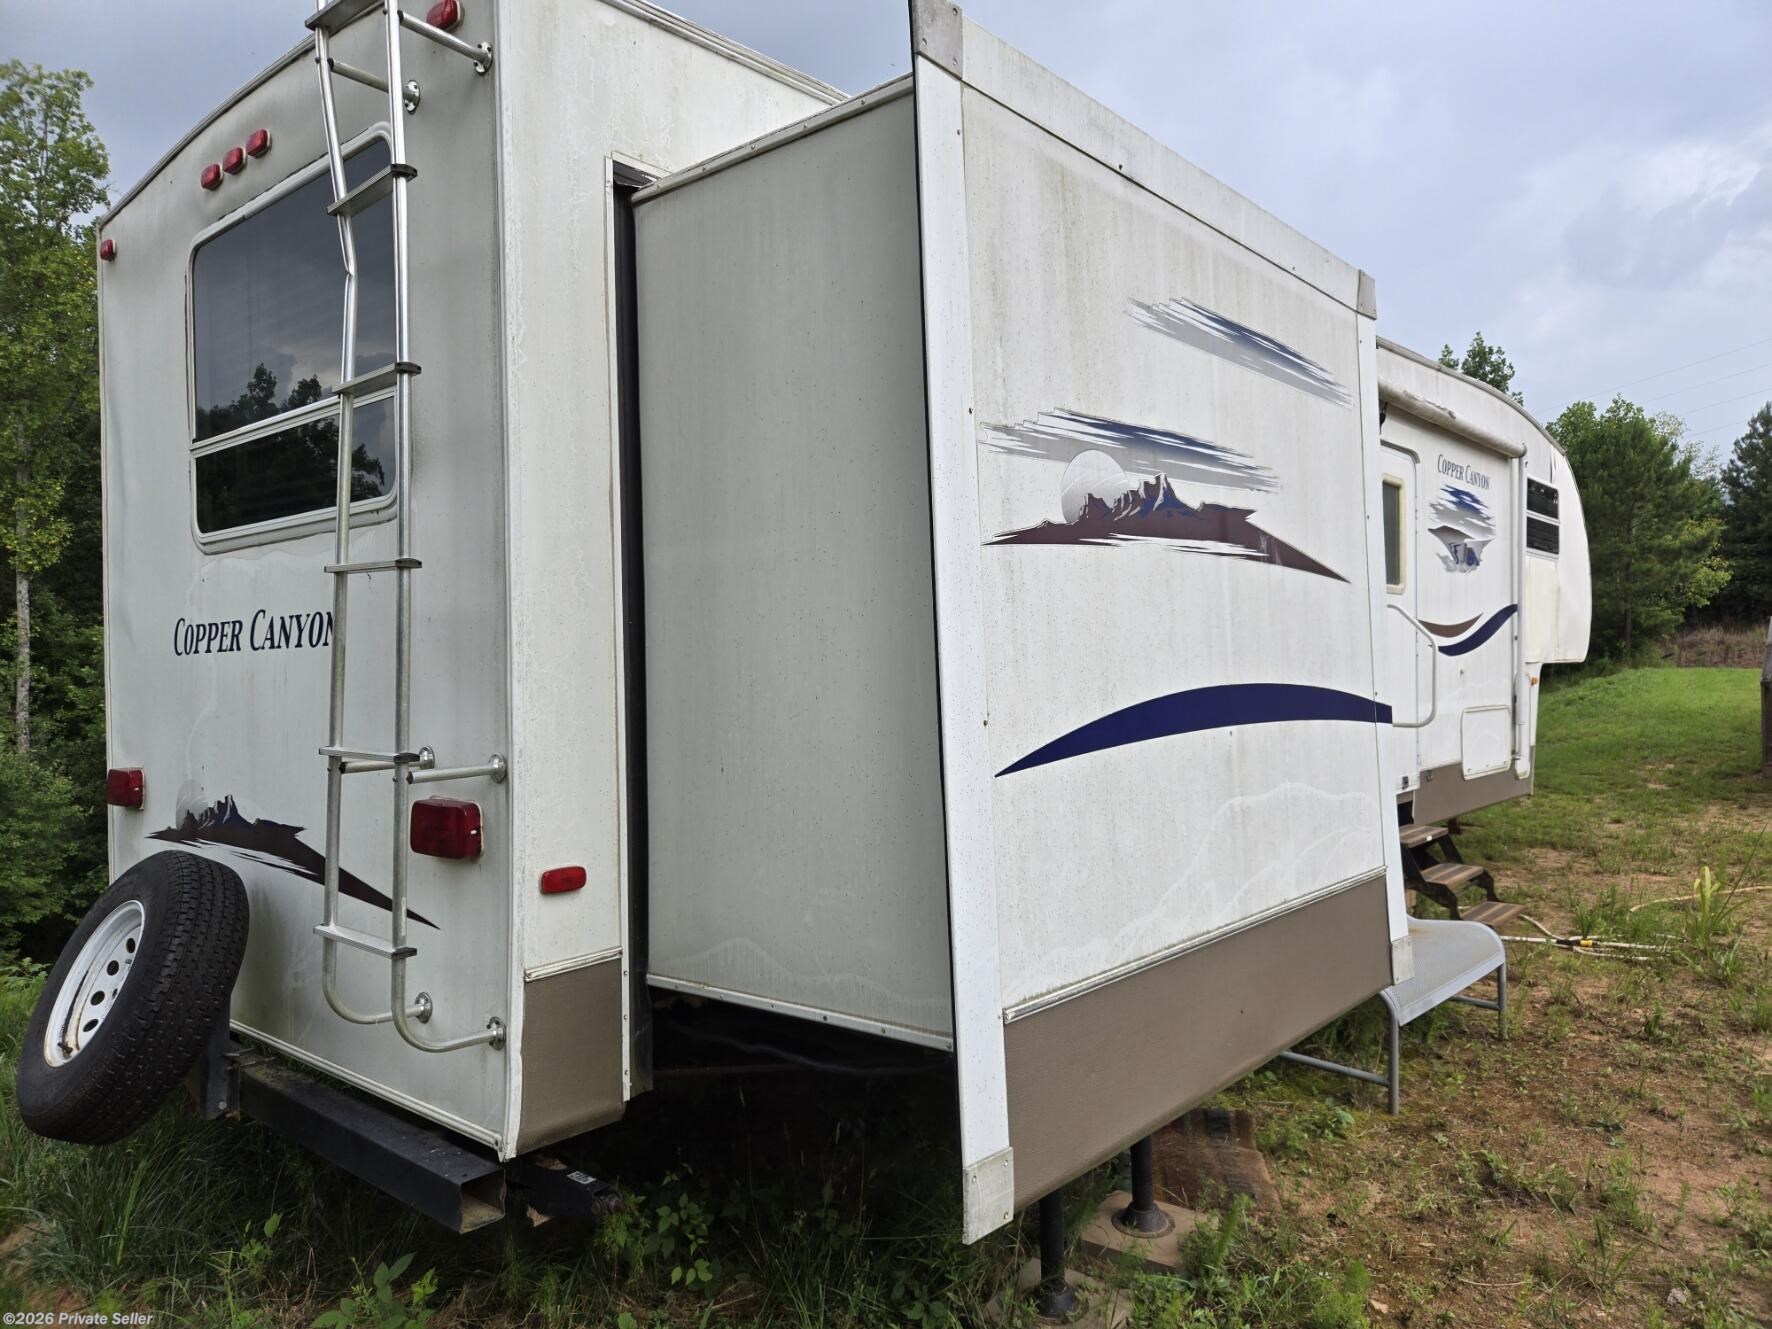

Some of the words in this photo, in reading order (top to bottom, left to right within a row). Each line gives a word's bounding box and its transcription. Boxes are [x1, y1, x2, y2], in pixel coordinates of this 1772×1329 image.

[1437, 454, 1464, 480] COPPER
[1465, 465, 1490, 489] CANYON
[174, 617, 243, 656] COPPER
